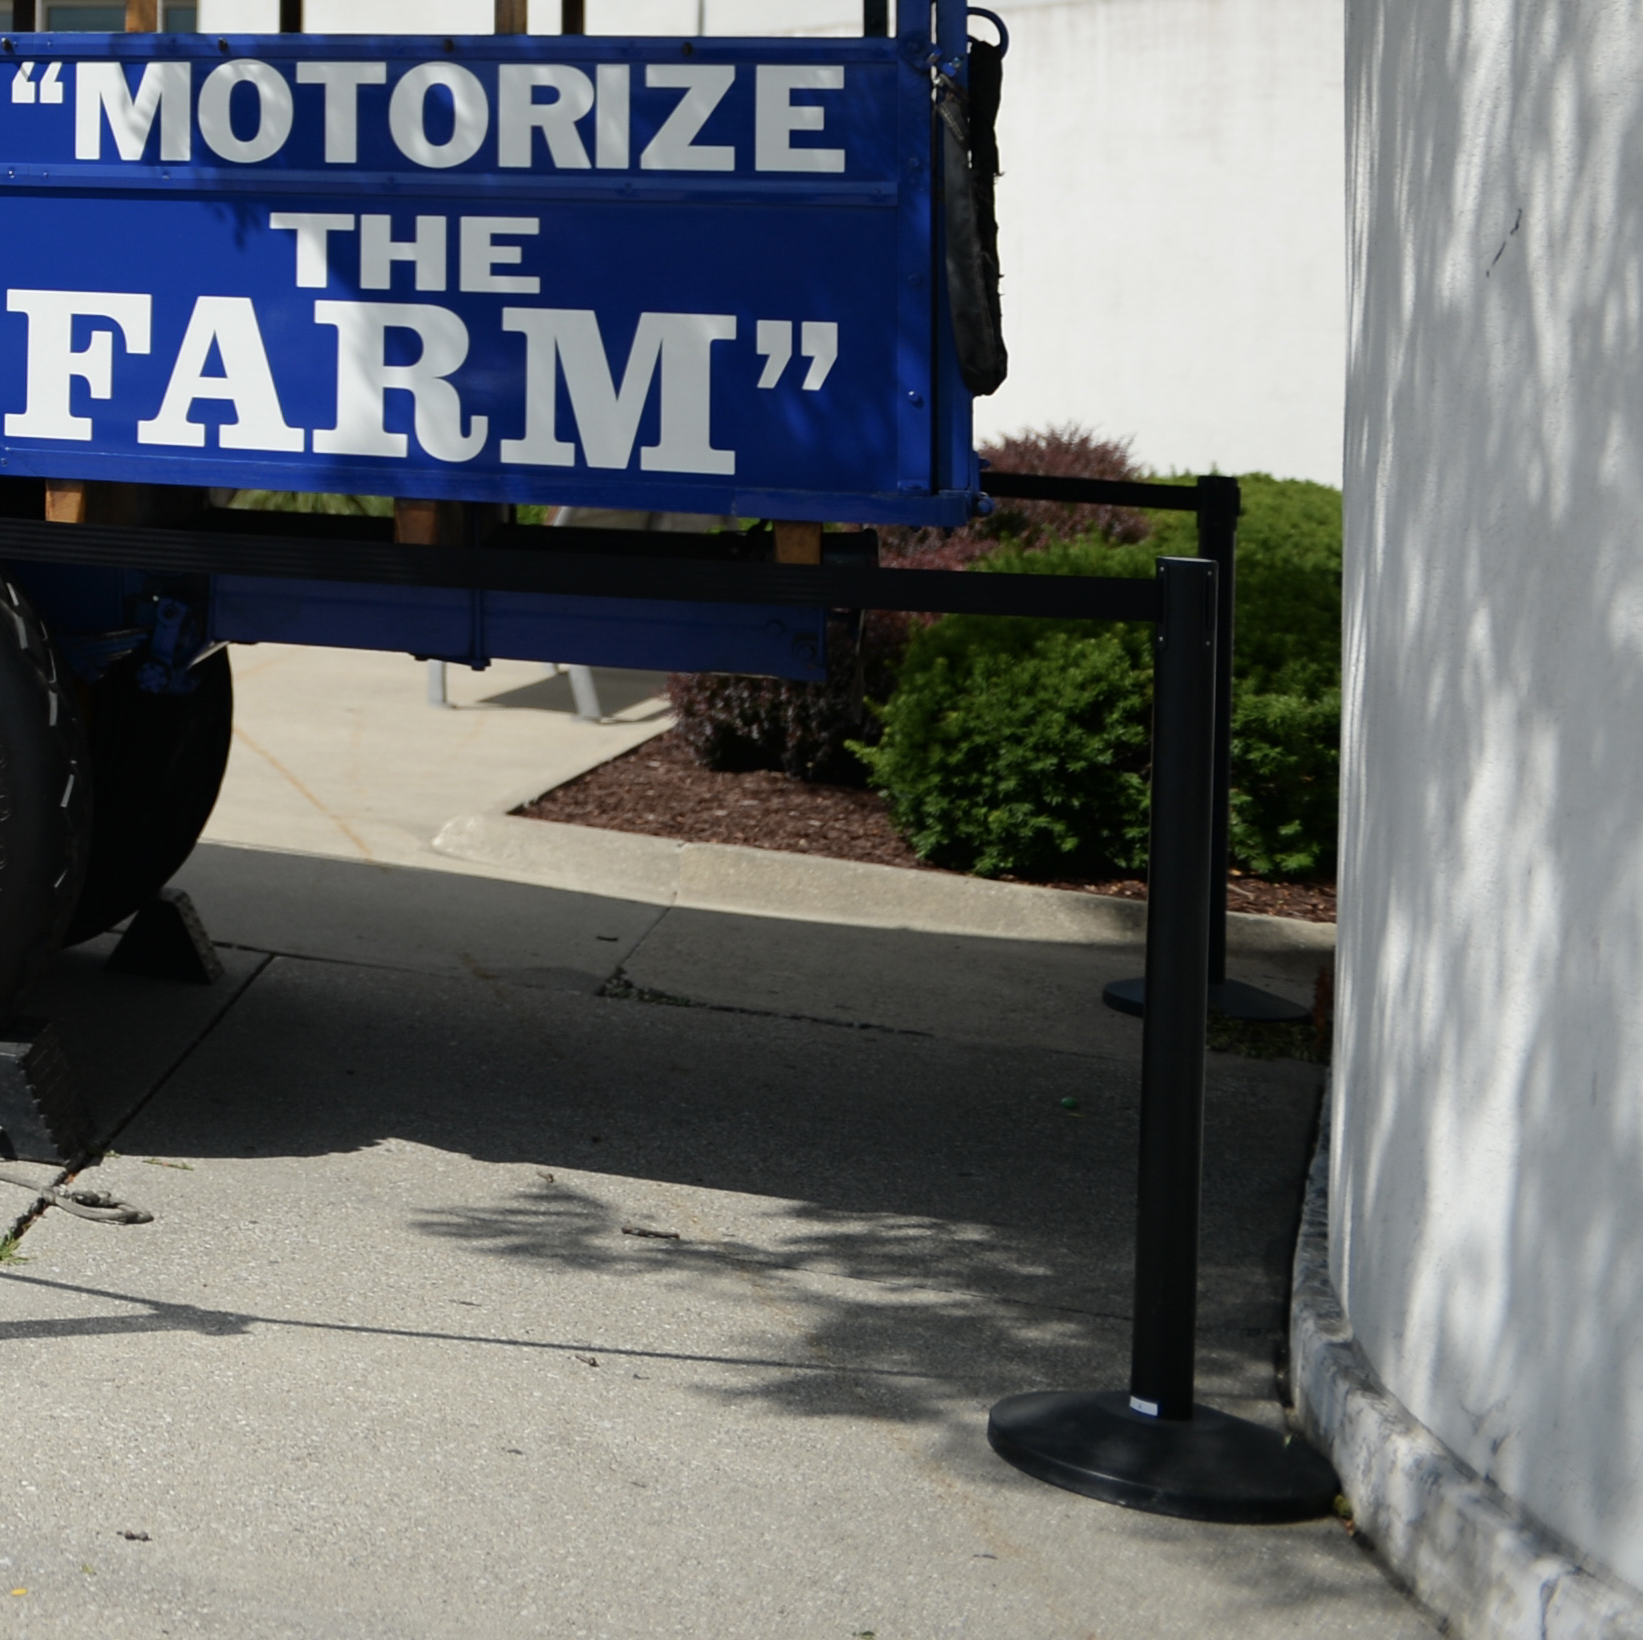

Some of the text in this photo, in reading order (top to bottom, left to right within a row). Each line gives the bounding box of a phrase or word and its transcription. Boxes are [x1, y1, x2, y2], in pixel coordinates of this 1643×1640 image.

[10, 57, 846, 174] “MOTORIZE
[269, 212, 542, 294] THE
[3, 289, 840, 476] FARM”
